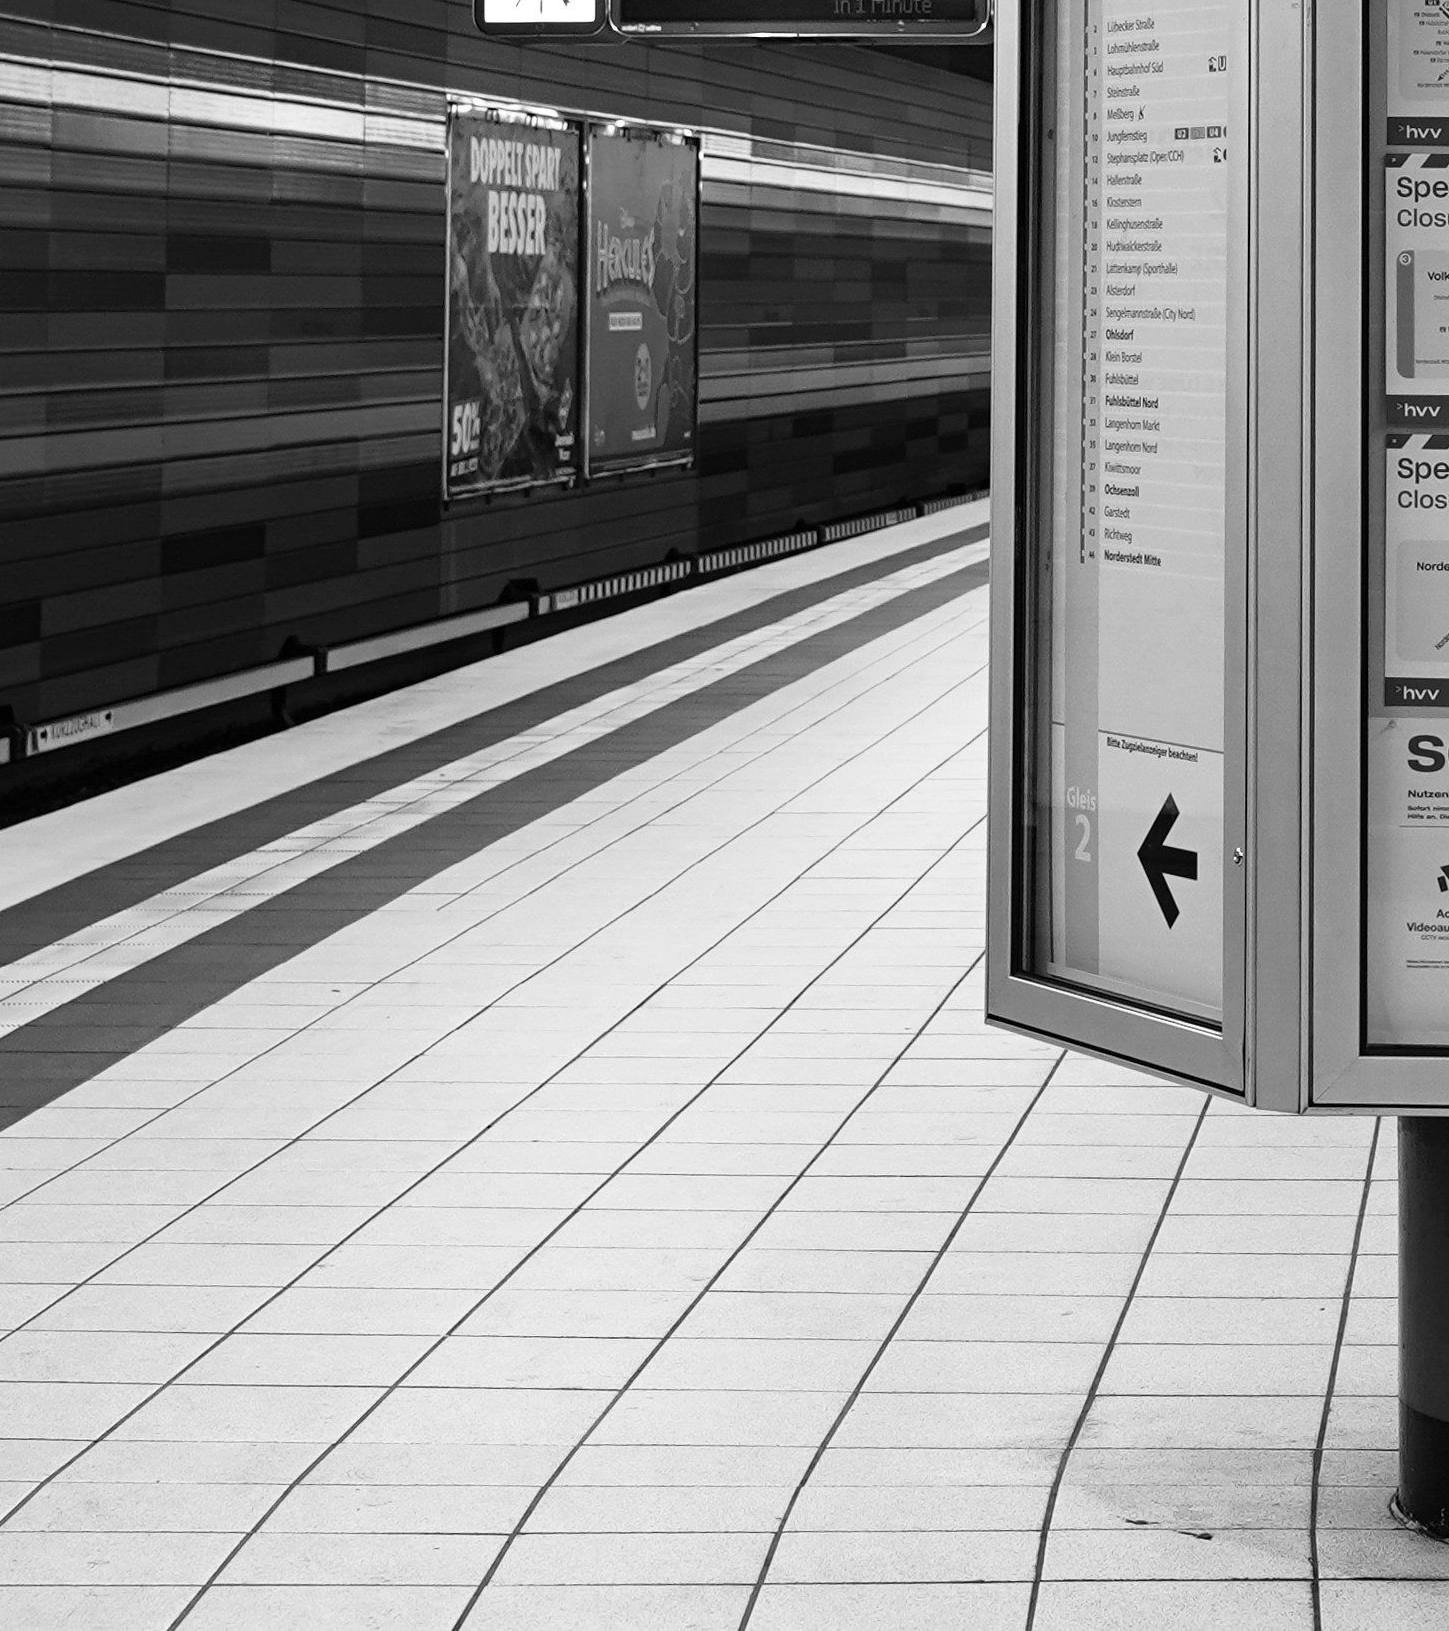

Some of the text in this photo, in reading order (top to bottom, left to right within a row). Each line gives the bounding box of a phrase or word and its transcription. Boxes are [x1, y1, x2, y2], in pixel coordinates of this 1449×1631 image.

[1107, 18, 1155, 33] Lübecker Straße
[1107, 40, 1159, 54] Lohmühlenstraße
[1151, 62, 1164, 73] Süd
[1107, 85, 1140, 98] Steinstraße
[1107, 108, 1135, 122] Meßberg
[1106, 130, 1147, 143] Jungfernstieg
[1405, 124, 1443, 139] hvv
[470, 136, 561, 192] DOPPELT SPART
[1106, 152, 1149, 165] Stephansplatz
[1106, 174, 1143, 186] Hallerstraße
[487, 190, 547, 256] BESSER
[1402, 254, 1409, 264] 3
[1105, 284, 1135, 296] Alsterdorf
[1163, 308, 1177, 322] (City
[1105, 329, 1135, 341] Ohlsdorf
[1105, 352, 1143, 364] Klein Borstel
[1105, 373, 1139, 386] Fuhlsbüttel
[1105, 395, 1159, 410] Fuhlsbüttel Nord
[1403, 404, 1441, 418] hvv
[1105, 417, 1161, 432] Langenhorn Markt
[1105, 439, 1158, 454] Langenhorn Nord
[1105, 484, 1139, 498] Ochsenzoll
[1104, 506, 1131, 520] Garstedt
[1104, 528, 1133, 544] Richtweg
[1104, 550, 1162, 568] Norderstedt Mitte
[1403, 686, 1440, 700] hvv
[1107, 736, 1121, 748] Bitte
[1167, 746, 1199, 762] beachten!
[1066, 786, 1097, 812] Gleis
[1407, 790, 1449, 799] Nutzen
[1073, 814, 1092, 862] 2
